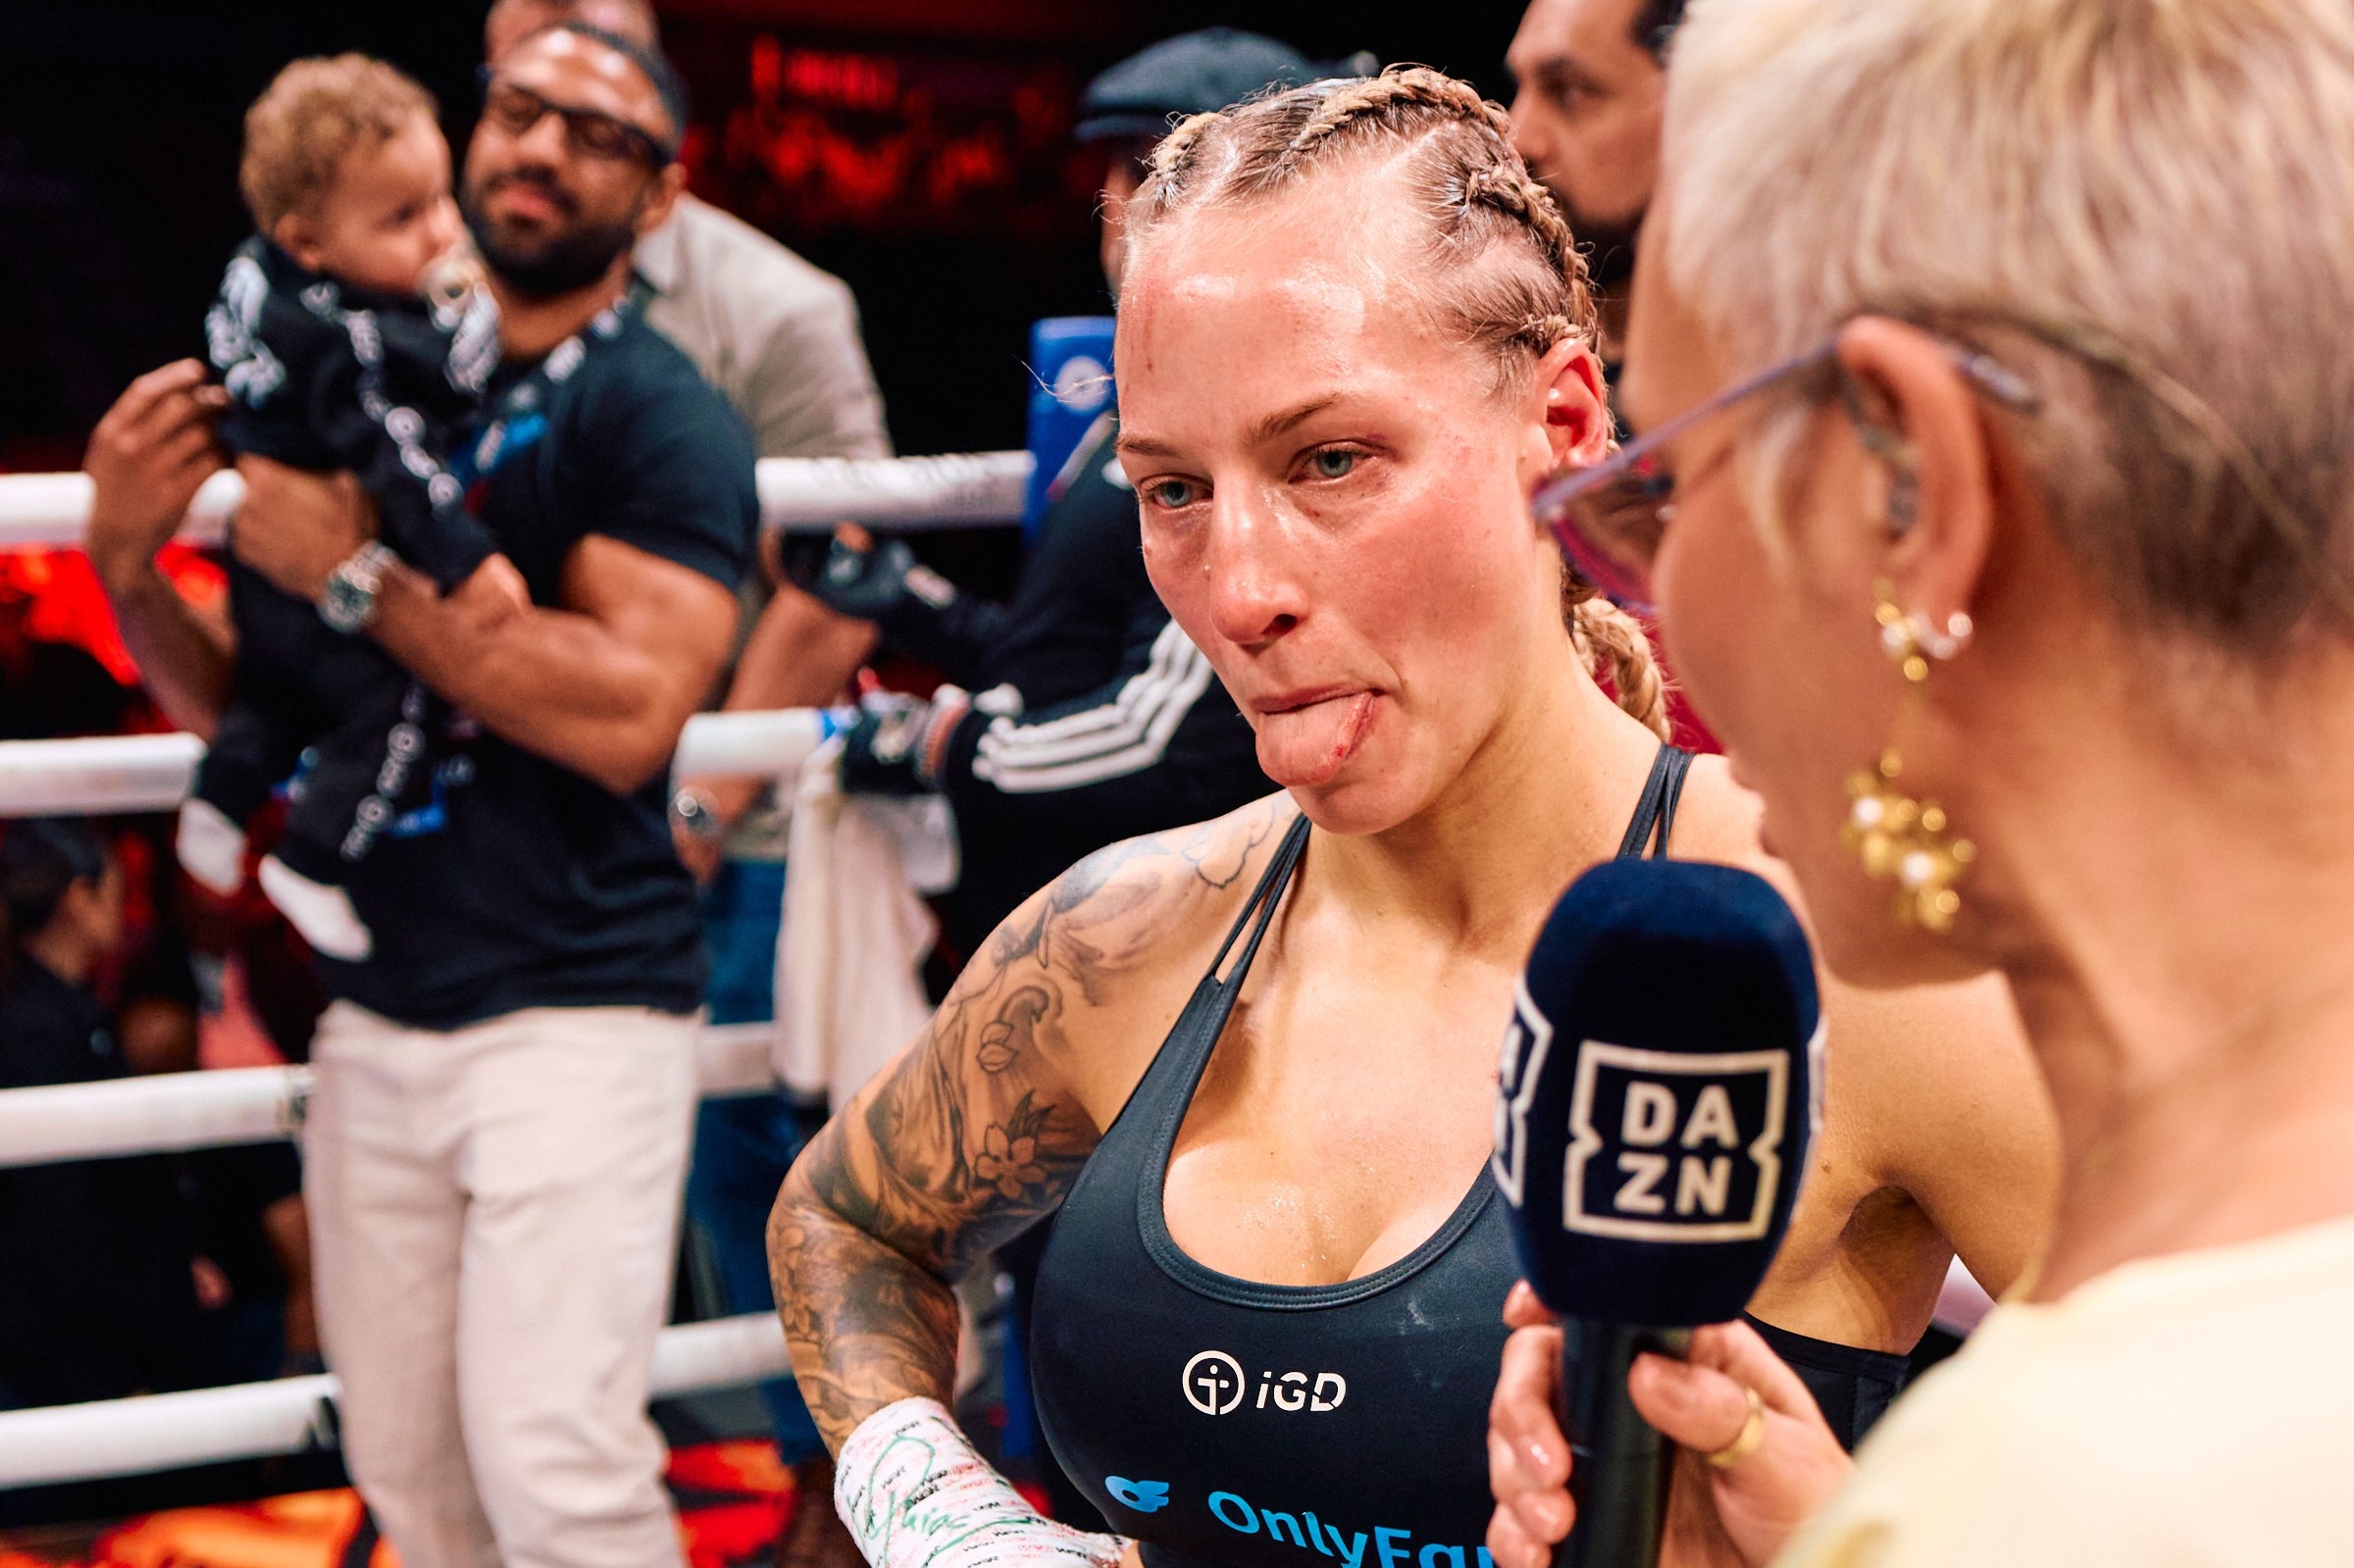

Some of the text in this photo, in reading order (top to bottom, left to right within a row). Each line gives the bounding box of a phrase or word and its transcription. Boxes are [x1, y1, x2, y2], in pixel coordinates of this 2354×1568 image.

[1620, 1080, 1739, 1149] DA
[1613, 1150, 1732, 1216] ZN
[1255, 1371, 1347, 1412] iGD
